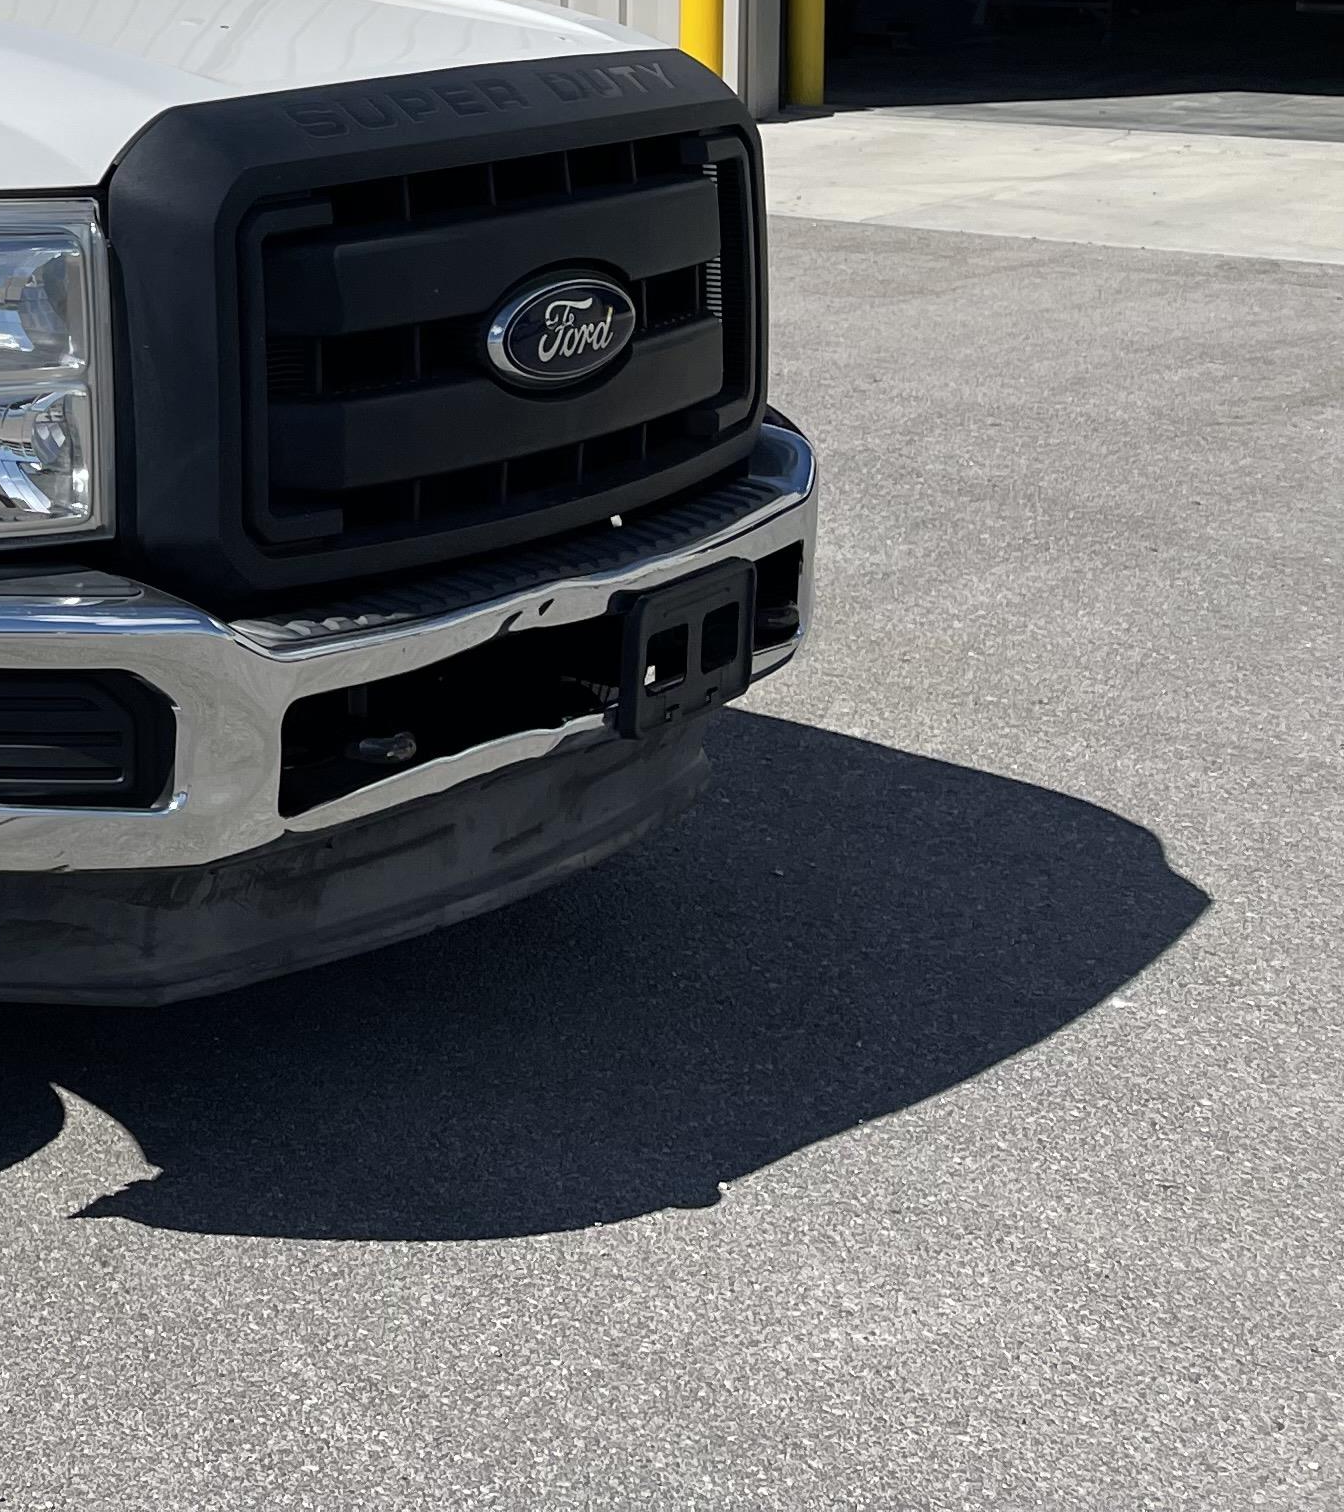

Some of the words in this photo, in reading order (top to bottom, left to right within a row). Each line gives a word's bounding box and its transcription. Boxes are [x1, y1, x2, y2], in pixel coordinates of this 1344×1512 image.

[283, 78, 532, 138] SUPER
[542, 62, 678, 102] DUTY
[537, 296, 615, 364] Ford
